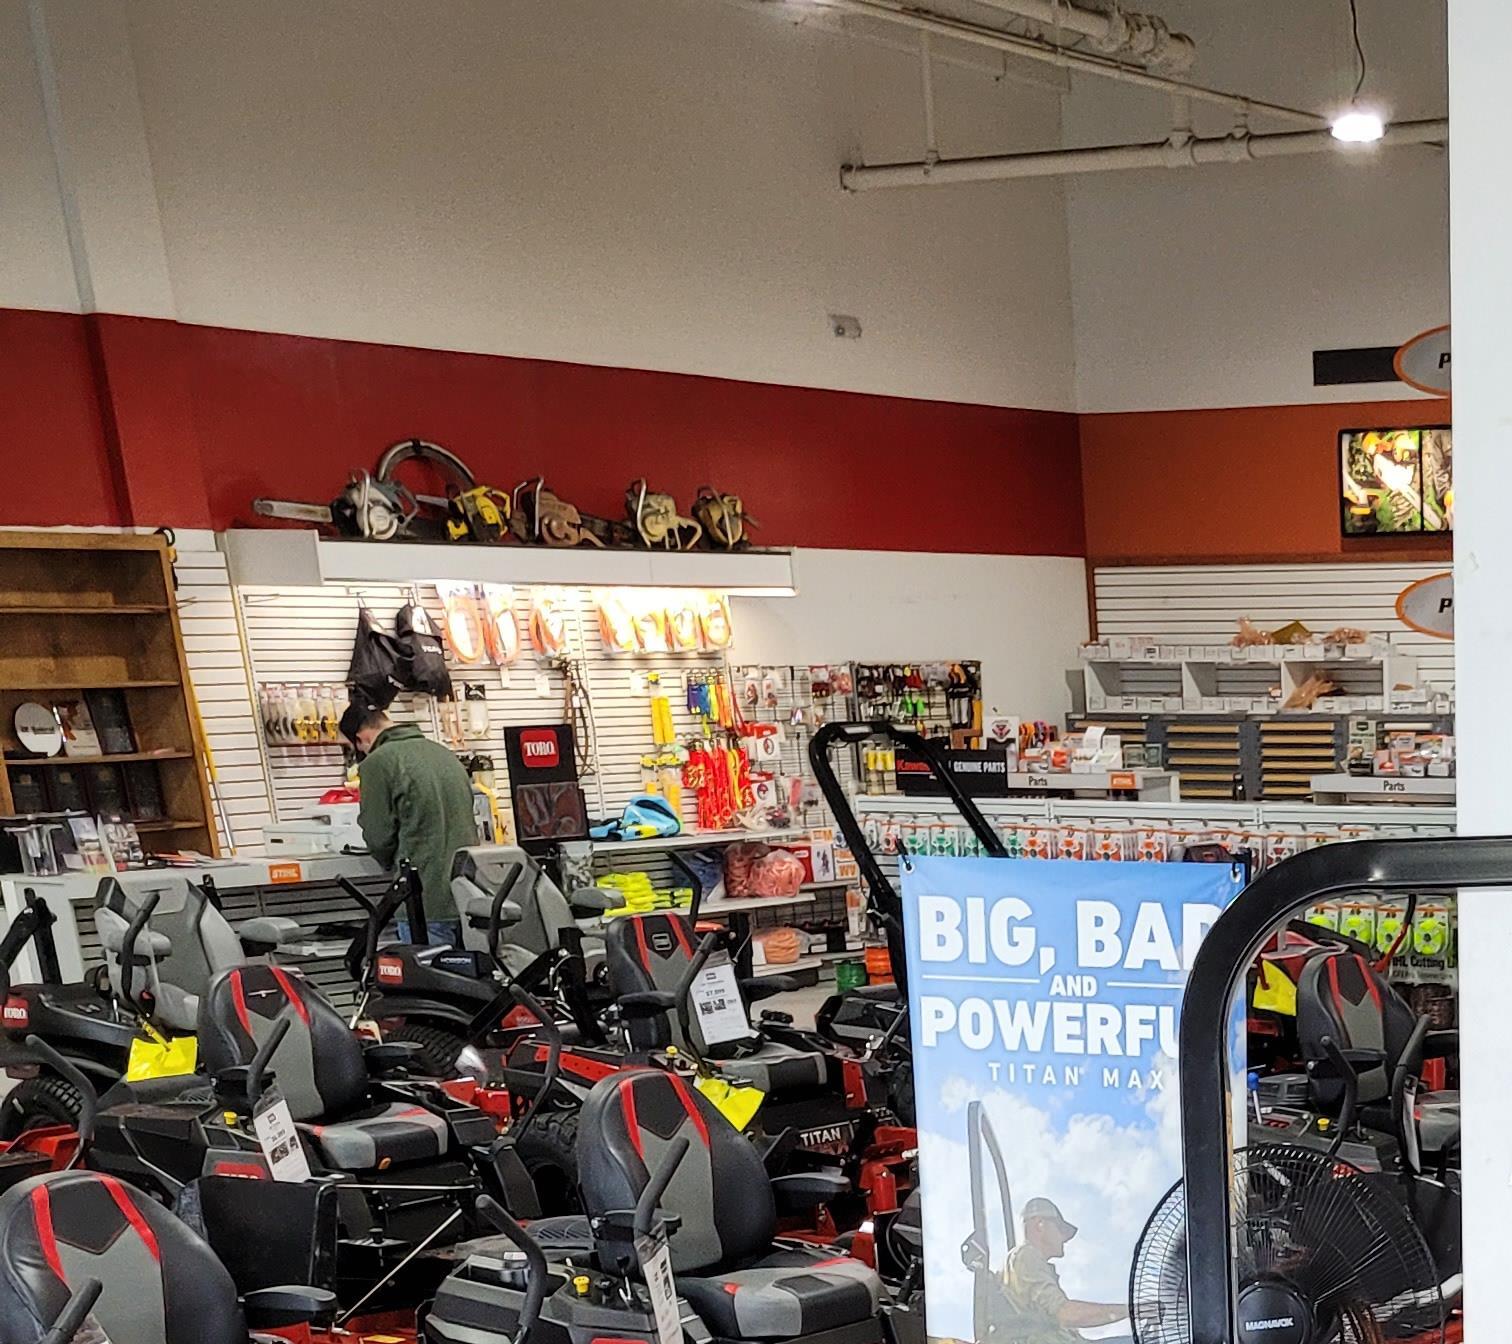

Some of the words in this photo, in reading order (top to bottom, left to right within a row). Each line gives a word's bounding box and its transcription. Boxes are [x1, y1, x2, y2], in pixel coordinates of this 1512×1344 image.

[524, 741, 556, 756] TORO
[953, 761, 982, 773] GENUINE
[983, 761, 1006, 773] PARTS
[1028, 775, 1048, 787] Parts
[1383, 780, 1405, 792] Parts
[918, 895, 1056, 975] BIG,
[379, 965, 402, 976] TORO
[1049, 975, 1098, 998] AND
[919, 996, 1180, 1060] POWERFU
[988, 1062, 1081, 1086] TITAN
[1103, 1067, 1164, 1090] MAX
[800, 1127, 841, 1147] TITAN
[1245, 1317, 1294, 1331] MAGNAVOX
